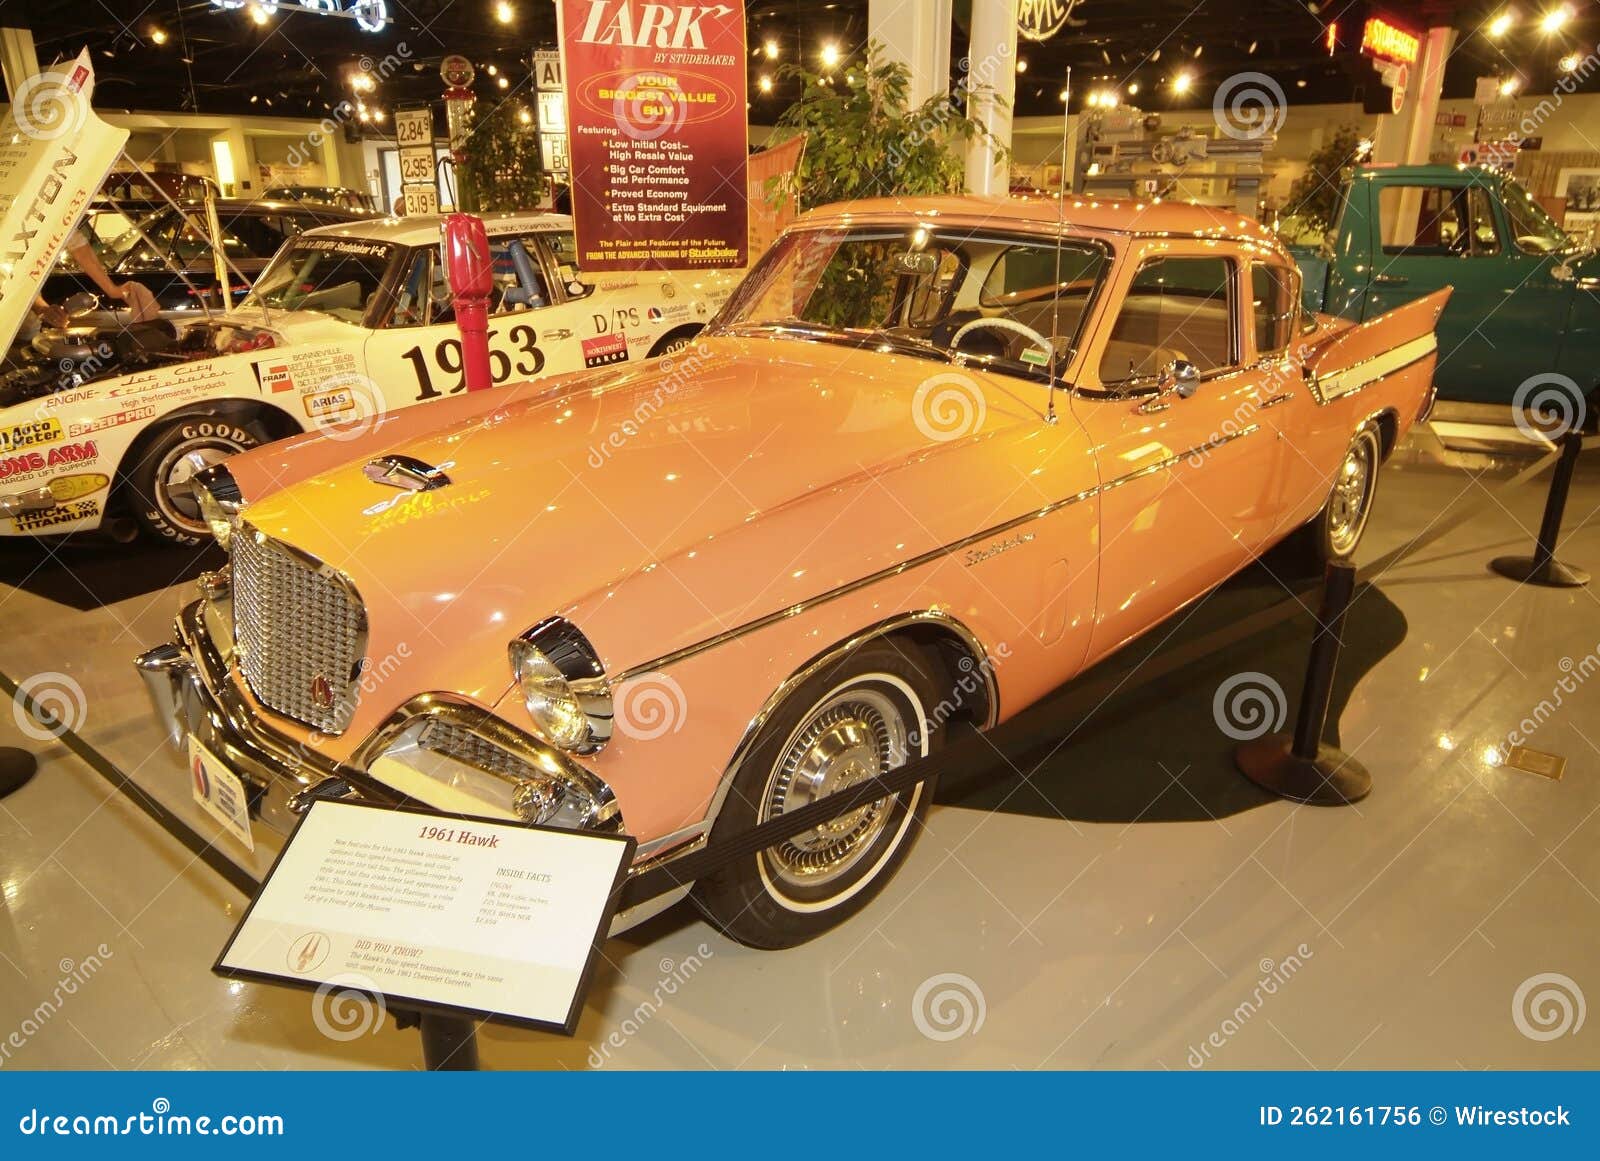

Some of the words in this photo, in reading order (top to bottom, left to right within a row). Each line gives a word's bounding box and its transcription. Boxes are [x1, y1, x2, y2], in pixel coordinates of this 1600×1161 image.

[575, 0, 733, 49] LARK
[654, 53, 668, 64] BY
[670, 53, 735, 66] STUDEBAKER
[636, 76, 677, 87] YOUR
[599, 90, 666, 101] BIGGEST
[669, 92, 717, 103] VALUE
[643, 106, 673, 116] BUY
[577, 125, 620, 137] Featuring:
[609, 140, 629, 150] Low
[632, 141, 657, 150] Initial
[609, 151, 631, 162] High
[635, 152, 665, 161] Resale
[668, 152, 694, 162] Value
[610, 165, 626, 176] Big
[629, 165, 645, 175] Car
[648, 165, 685, 175] Comfort
[611, 175, 628, 184] and
[632, 175, 690, 185] Performance
[611, 189, 644, 199] Proved
[646, 190, 688, 201] Economy
[612, 203, 634, 212] Extra
[637, 203, 679, 213] Standard
[681, 203, 727, 214] Equipment
[613, 214, 622, 222] at
[624, 213, 636, 222] No
[638, 213, 662, 222] Extra
[664, 213, 685, 222] Cost
[600, 240, 613, 248] The
[634, 240, 646, 248] and
[704, 239, 726, 247] Future
[604, 252, 617, 260] THE
[618, 251, 650, 260] ADVANCED
[651, 250, 680, 259] THINKING
[688, 248, 739, 258] Studebaker
[402, 325, 546, 401] 1963
[589, 352, 625, 365] CARGO
[262, 373, 287, 383] FRAM
[141, 388, 192, 405] Performance
[193, 380, 227, 393] Products
[312, 393, 346, 409] ARIAS
[69, 405, 156, 438] SPEED-PRO
[47, 440, 99, 467] ARM
[38, 469, 56, 478] LIFT
[60, 459, 97, 473] SUPPORT
[15, 506, 70, 523] TRICK
[15, 508, 99, 531] TITANIUM
[418, 826, 454, 843] 1961
[455, 831, 499, 849] Hawk
[496, 867, 525, 879] INSIDE
[526, 872, 552, 883] FACTS
[354, 940, 371, 950] DID
[374, 942, 391, 952] YOU
[392, 945, 424, 957] KNOW?
